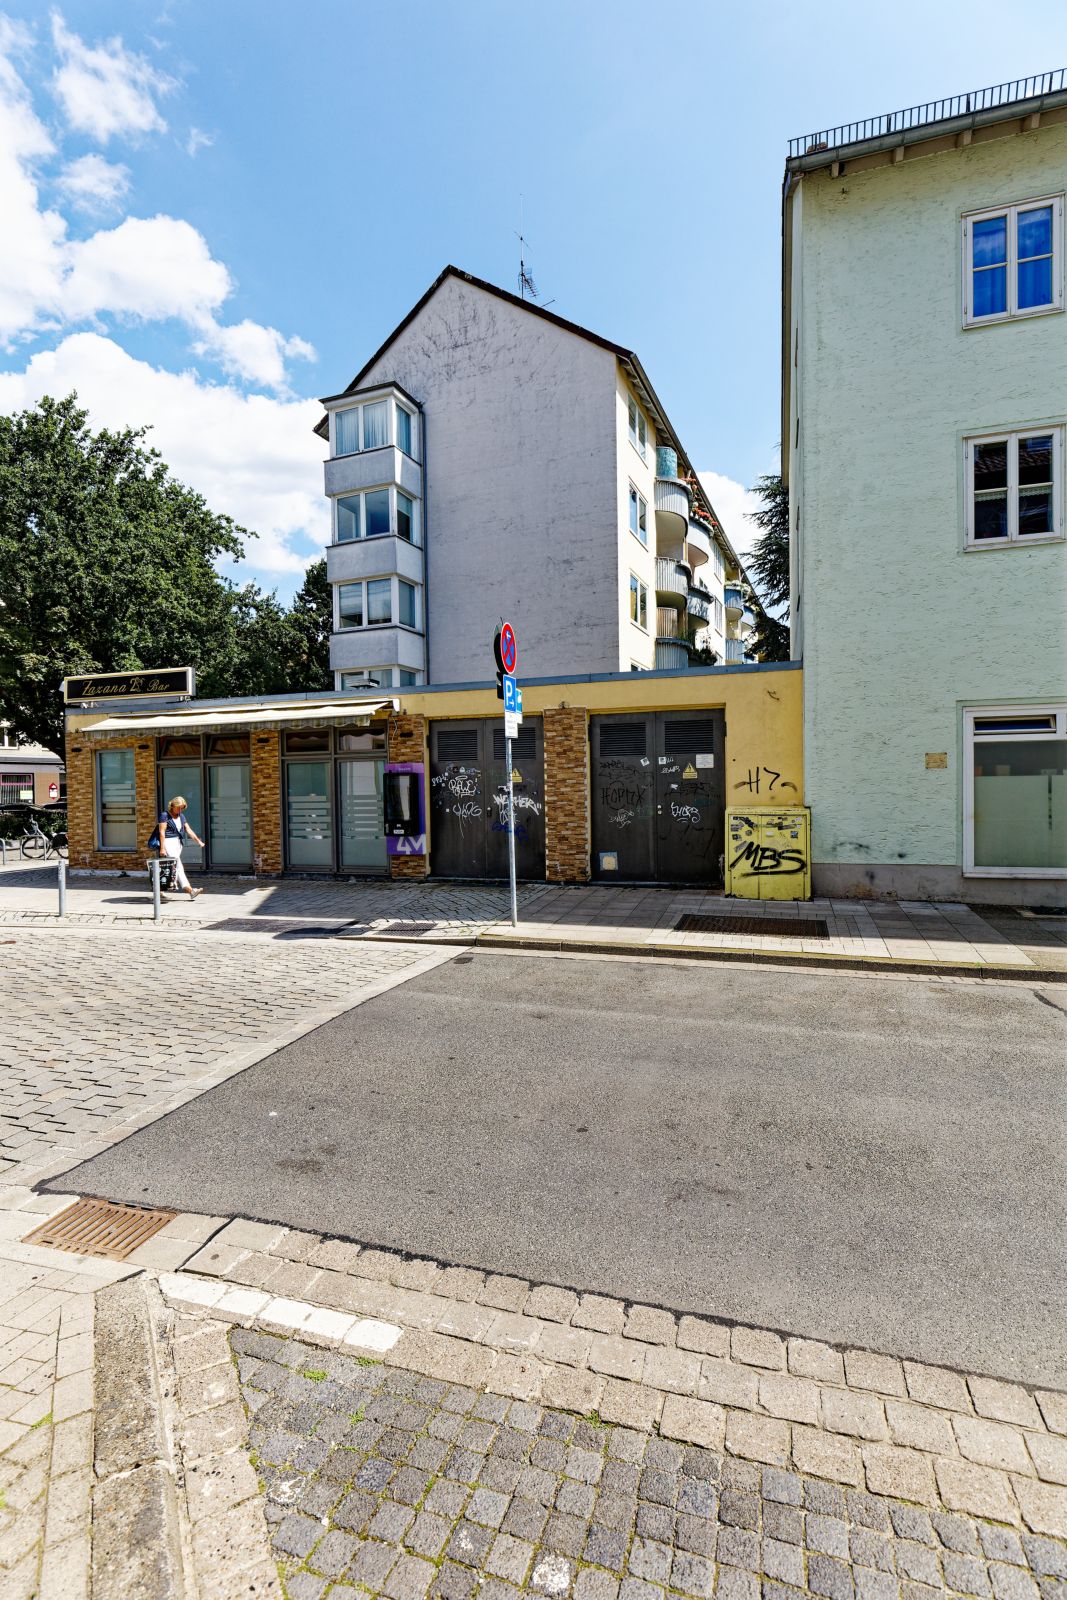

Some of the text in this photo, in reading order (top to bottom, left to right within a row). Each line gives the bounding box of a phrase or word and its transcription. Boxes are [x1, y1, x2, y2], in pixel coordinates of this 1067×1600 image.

[147, 680, 170, 692] Bar
[505, 680, 513, 706] P
[729, 841, 807, 876] MBS
